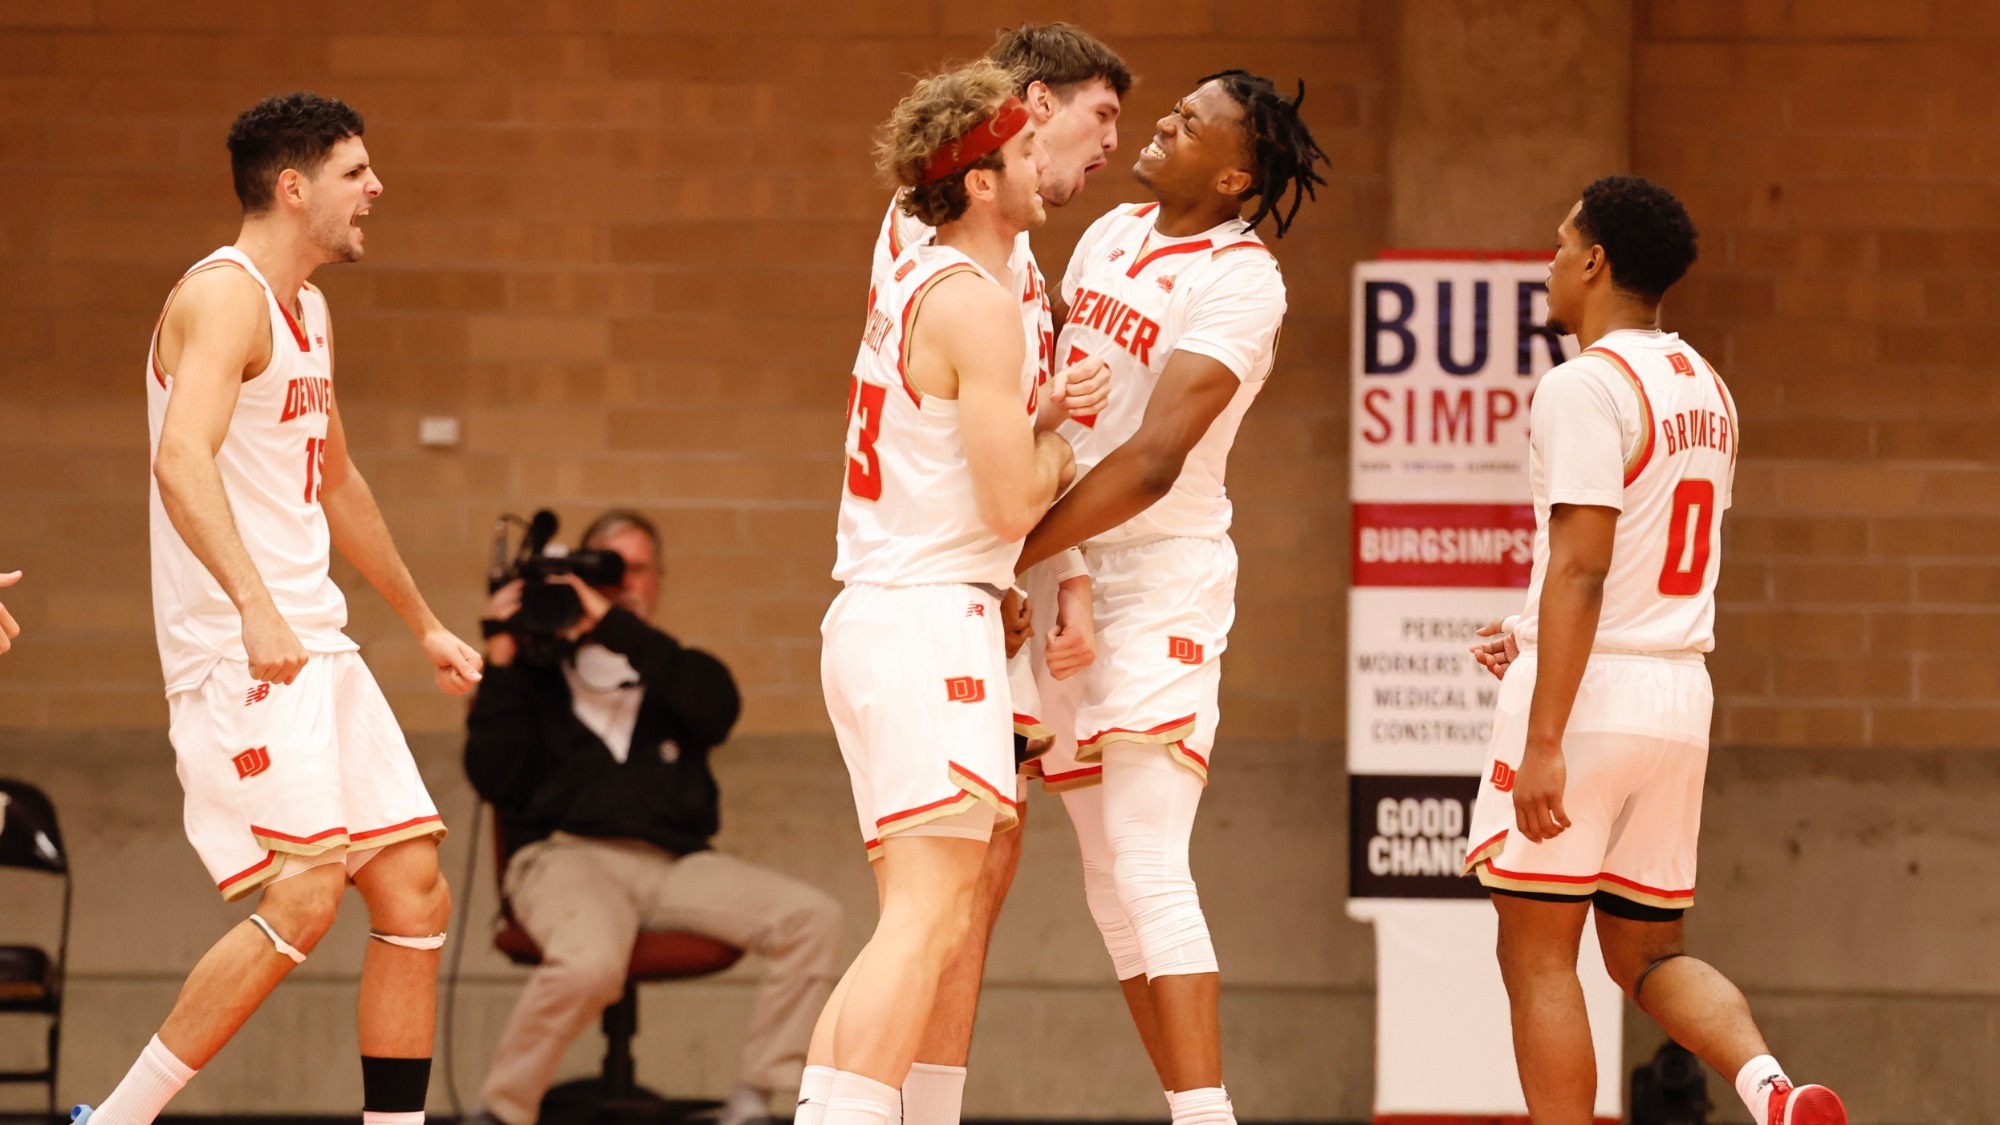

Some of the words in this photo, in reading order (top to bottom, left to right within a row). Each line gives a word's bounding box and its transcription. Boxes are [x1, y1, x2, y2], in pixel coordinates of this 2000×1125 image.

[1065, 287, 1160, 368] DENVER
[1365, 281, 1566, 376] BUR
[279, 376, 330, 424] DENVE
[1364, 388, 1536, 445] SIMP
[1662, 409, 1728, 457] BRUNER
[1360, 527, 1536, 564] BURGSIMPS
[1657, 478, 1714, 598] 0
[1403, 618, 1488, 641] PERSON
[1375, 686, 1466, 708] MEDICAL
[1372, 720, 1494, 744] CONSTRUC
[1376, 797, 1464, 838] GOOD
[1368, 835, 1469, 876] CHANG
